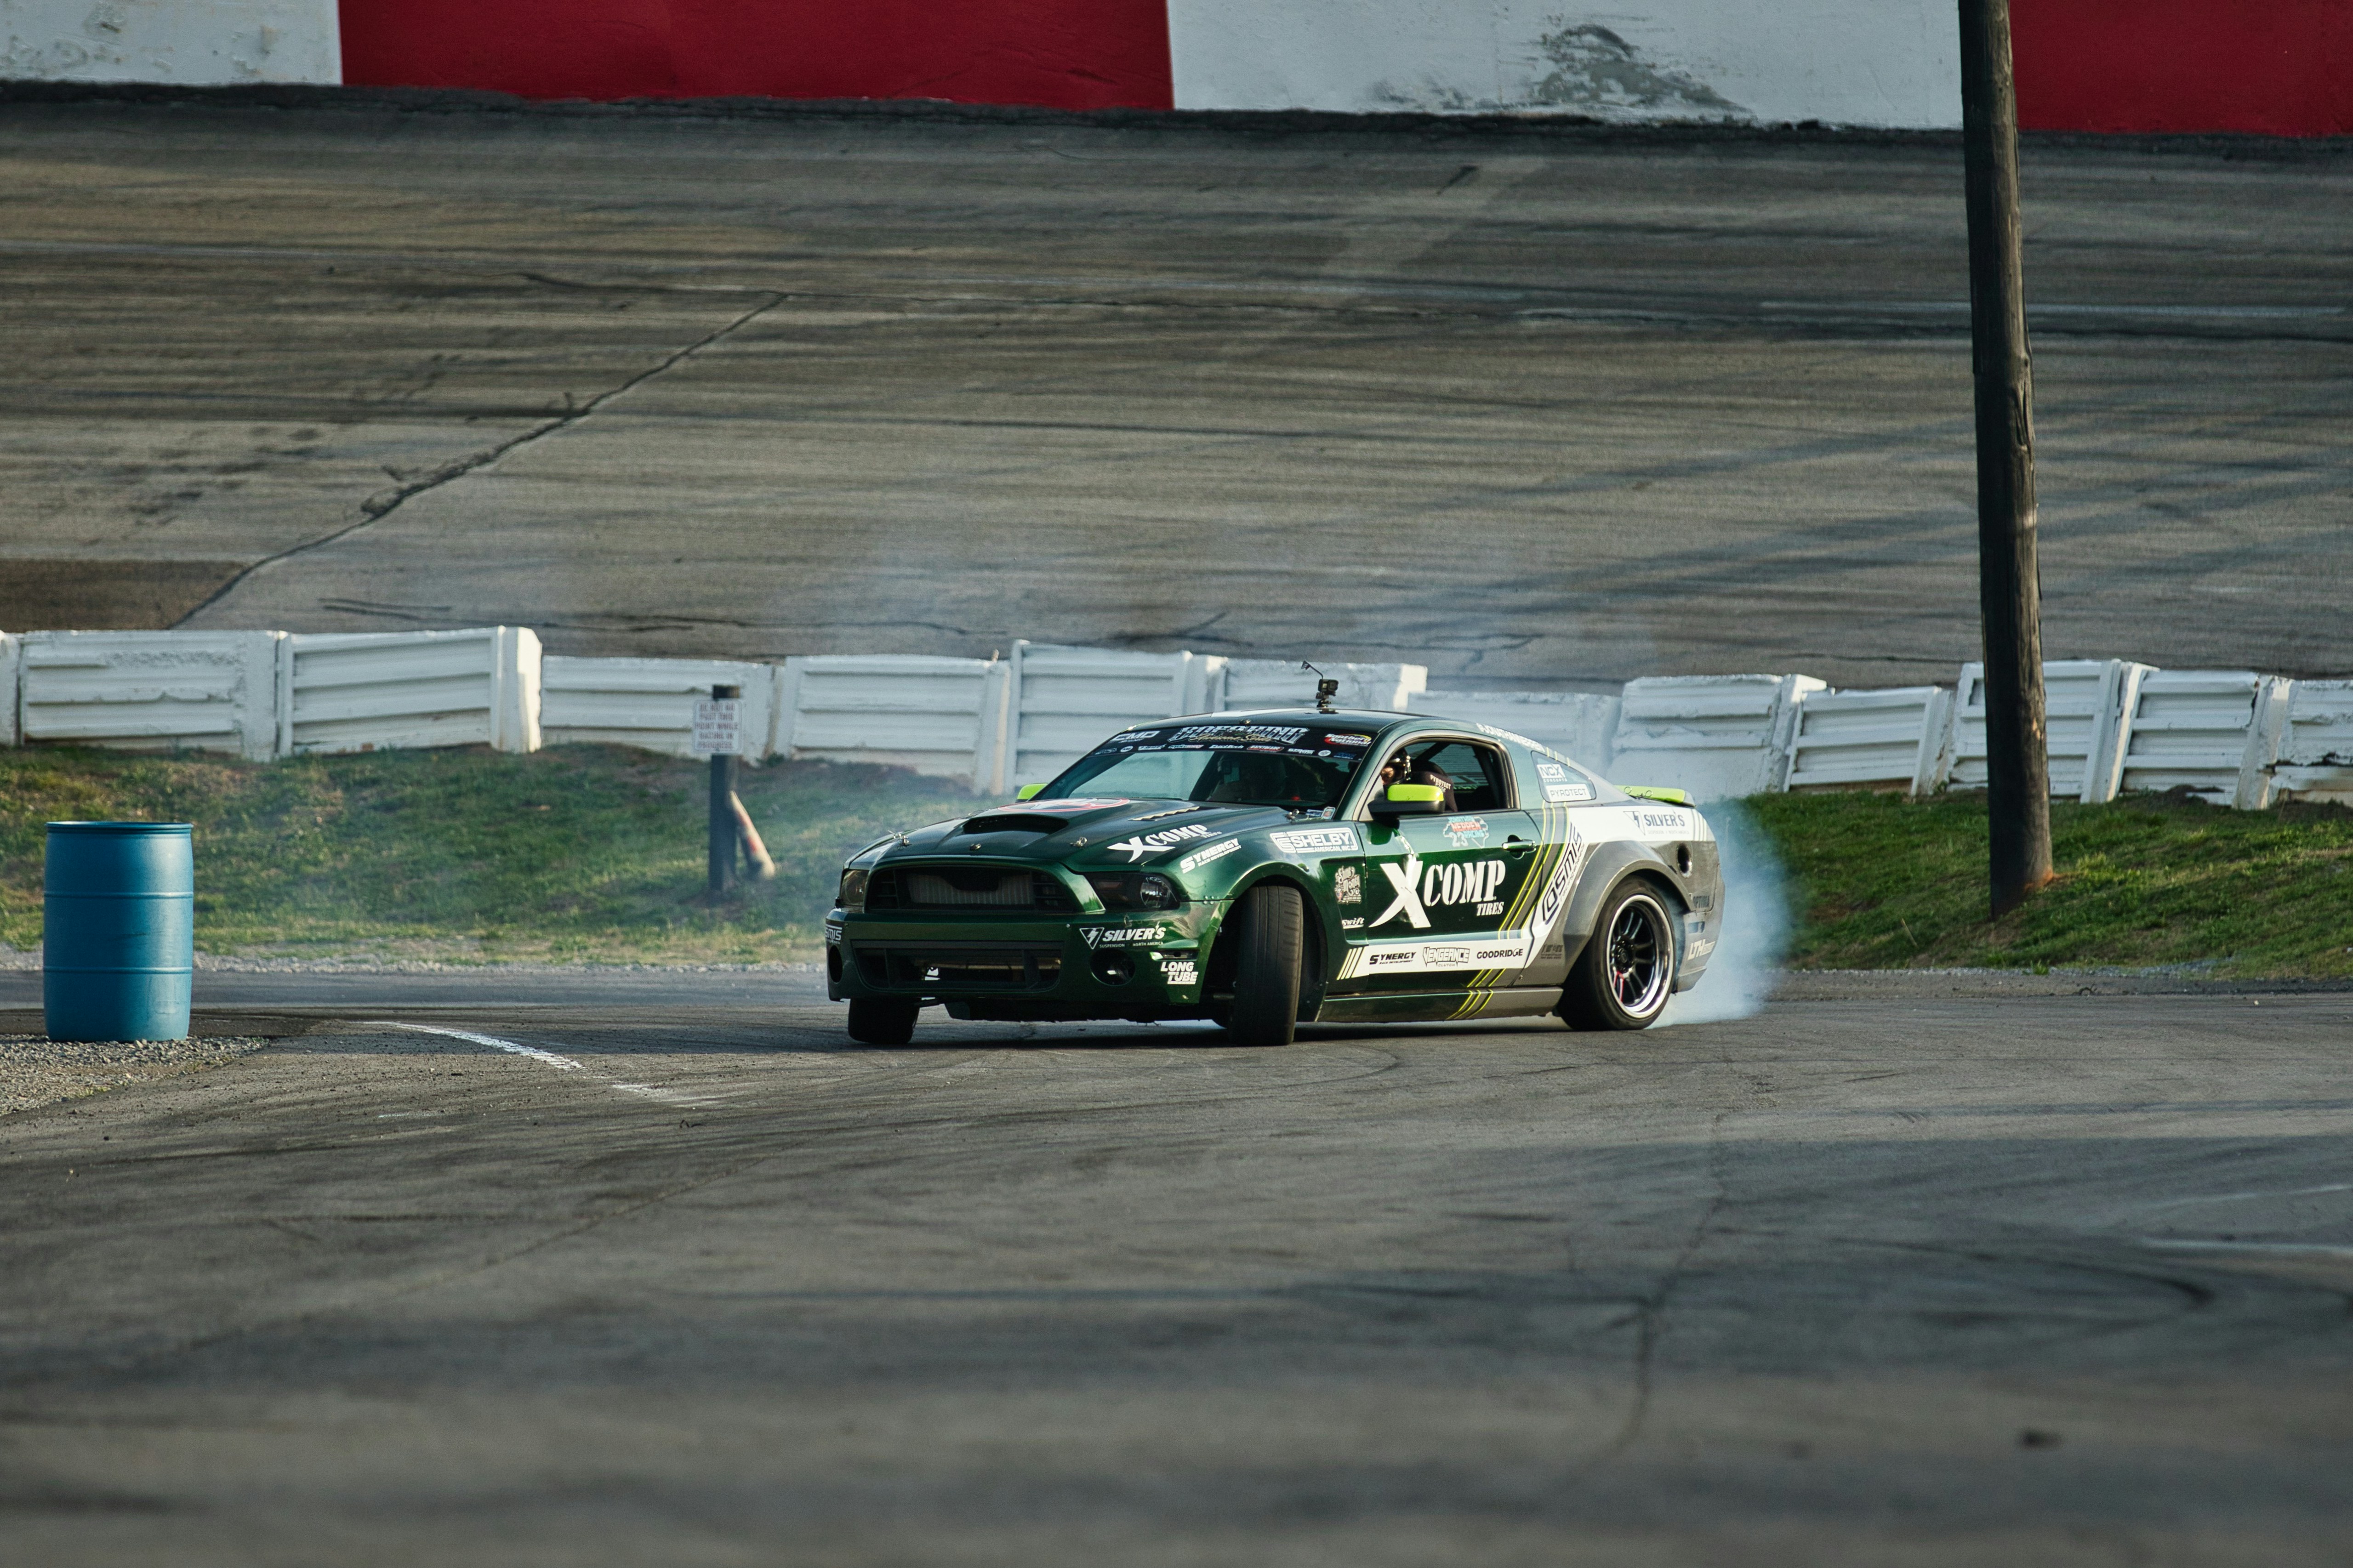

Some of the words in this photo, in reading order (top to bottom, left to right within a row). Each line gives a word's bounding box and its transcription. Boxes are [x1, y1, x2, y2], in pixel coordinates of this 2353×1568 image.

[1550, 789, 1587, 797] PYROTECT
[1644, 812, 1685, 827] SILVER'S
[1290, 833, 1350, 847] SHELBY
[1449, 832, 1468, 847] 23
[1180, 838, 1239, 874] SYNERGY
[1476, 902, 1504, 916] TIRES
[1102, 923, 1166, 942] SILVER'S
[1369, 952, 1416, 965] SYNERGY
[1423, 947, 1470, 966] VENGEANCE
[1477, 948, 1523, 959] GOODRIDGE
[1160, 961, 1194, 971] LONG
[1168, 971, 1198, 981] TUBE
